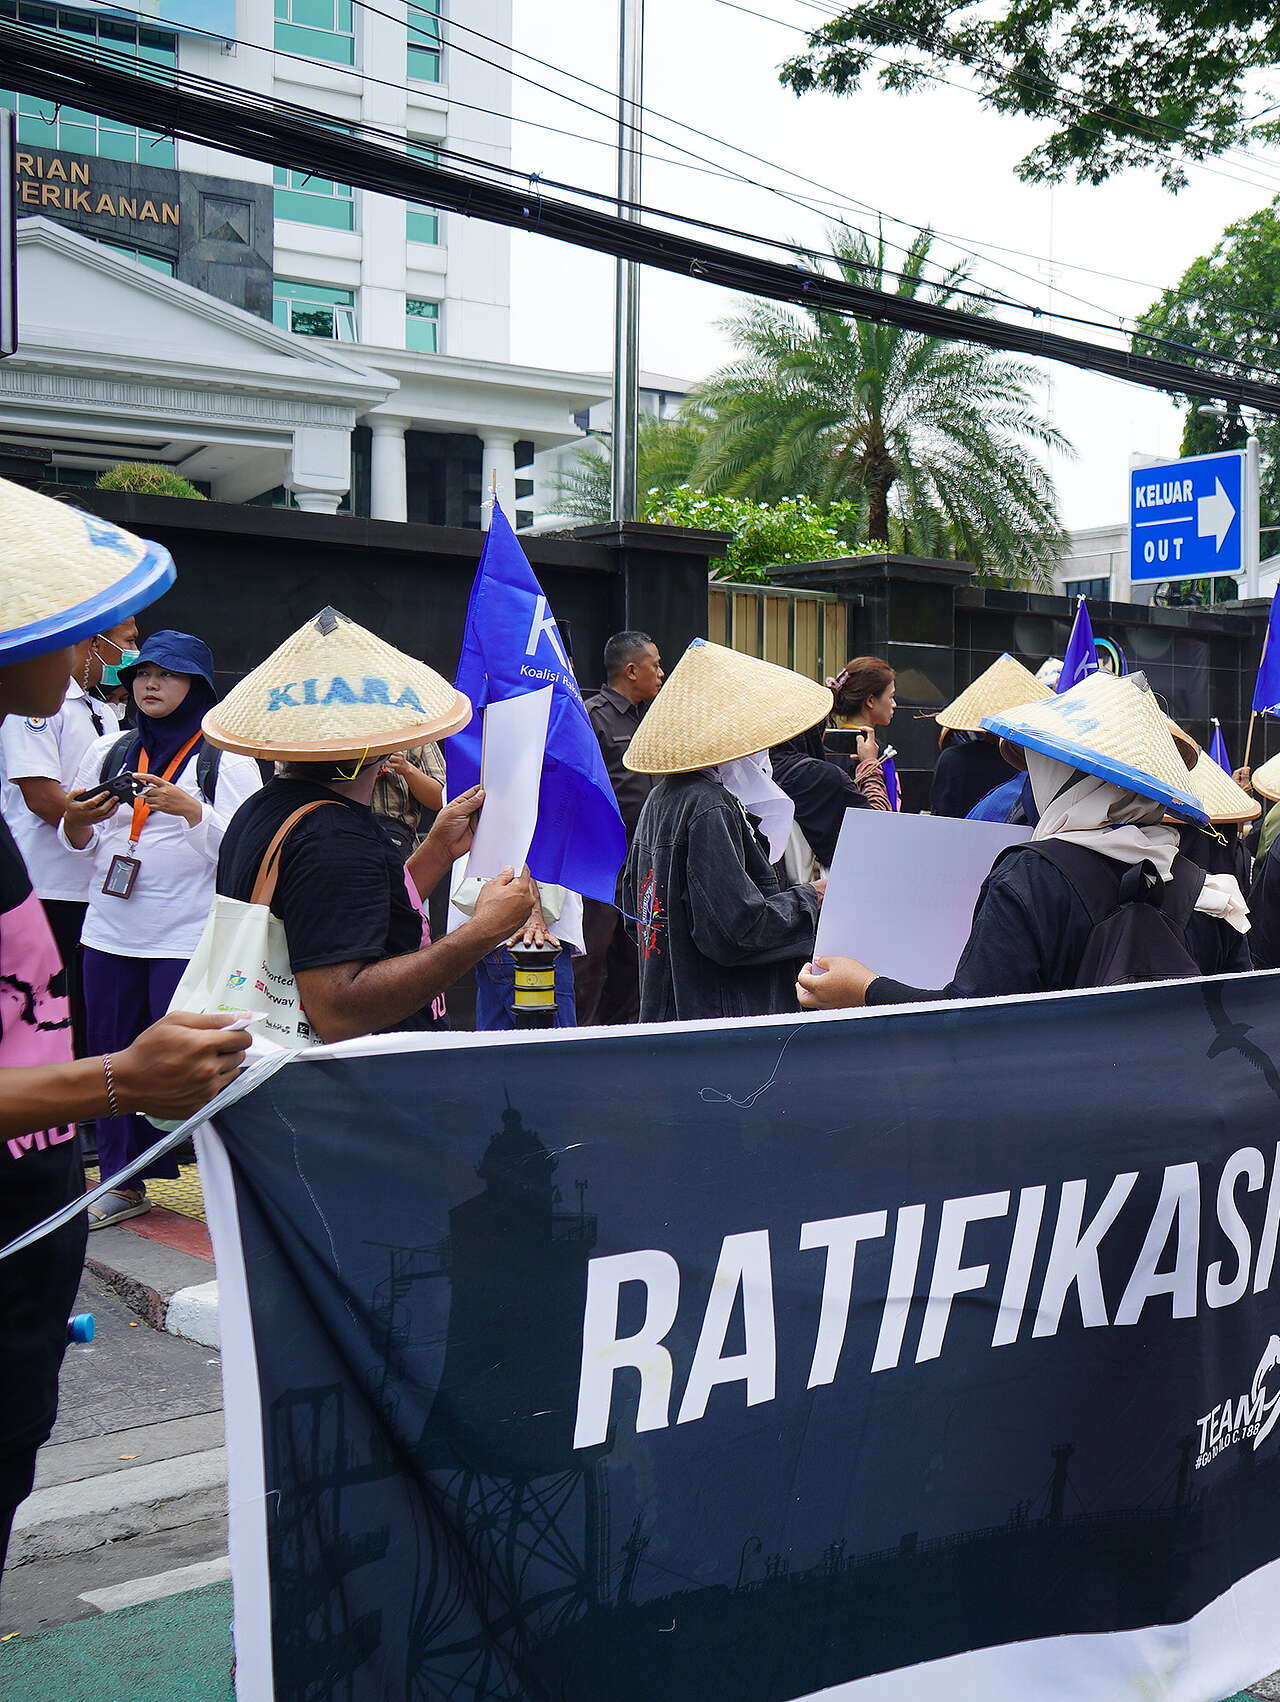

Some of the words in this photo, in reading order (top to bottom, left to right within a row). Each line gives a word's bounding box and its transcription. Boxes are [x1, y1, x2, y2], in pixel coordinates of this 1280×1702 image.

[16, 181, 180, 226] ERIKANAN
[1135, 479, 1194, 509] KELUAR
[1143, 537, 1184, 563] OUT
[520, 664, 560, 683] Koalisi
[267, 676, 428, 715] KIARA
